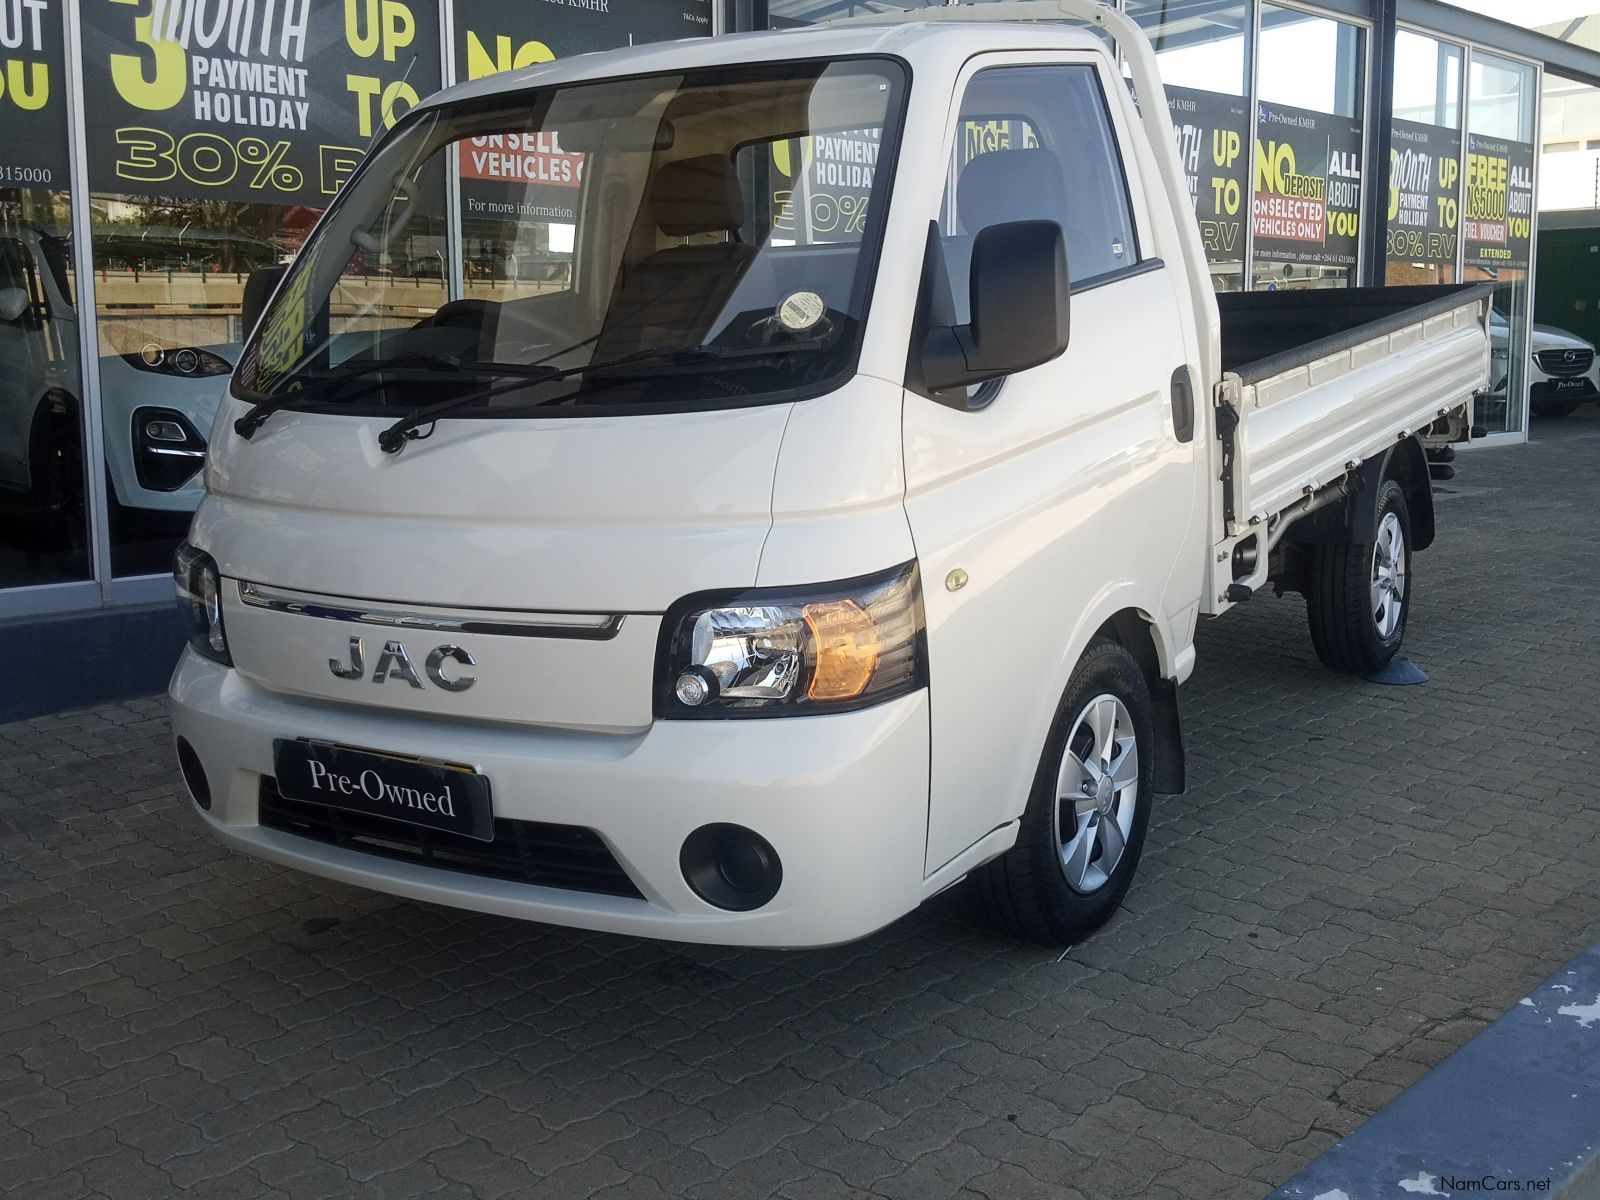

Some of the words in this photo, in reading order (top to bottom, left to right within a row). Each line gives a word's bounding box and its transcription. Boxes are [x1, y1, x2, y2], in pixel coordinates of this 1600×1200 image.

[344, 0, 416, 62] UP
[192, 55, 308, 98] PAYMENT
[194, 89, 310, 131] HOLIDAY
[346, 74, 421, 138] TO
[1176, 99, 1197, 112] KMHR
[1268, 111, 1298, 126] Pre-Owned
[1298, 116, 1316, 130] KMHR
[115, 127, 304, 192] 30%
[815, 135, 881, 167] PAYMENT
[1213, 129, 1240, 168] UP
[471, 150, 571, 182] VEHICLES
[816, 161, 876, 188] HOLIDA
[1255, 138, 1296, 195] NO
[1328, 150, 1360, 179] ALL
[1438, 157, 1458, 189] UP
[1467, 153, 1508, 190] FREE
[1509, 165, 1532, 189] ALL
[1211, 177, 1240, 216] TO
[1283, 172, 1325, 201] DEPOSIT
[1327, 180, 1360, 209] ABOUT
[468, 199, 486, 212] For
[488, 203, 514, 214] more
[517, 202, 573, 218] information
[1254, 199, 1268, 216] ON
[1268, 198, 1323, 221] SELECTED
[1399, 192, 1429, 211] PAYMENT
[1437, 197, 1457, 229] TO
[1465, 184, 1506, 221] N$5000
[1508, 191, 1531, 215] ABOUT
[1253, 217, 1296, 238] VEHICLES
[1297, 221, 1322, 239] ONLY
[1326, 210, 1358, 237] YOU
[1398, 209, 1428, 226] HOLIDAY
[1464, 221, 1478, 239] FUEL
[1480, 223, 1505, 241] VOUCHER
[1508, 217, 1530, 239] YOU
[1200, 221, 1240, 251] RV
[1427, 232, 1457, 259] RV
[1479, 248, 1512, 259] EXTENDED
[328, 635, 477, 693] JAC
[306, 758, 456, 817] Pre-Owned
